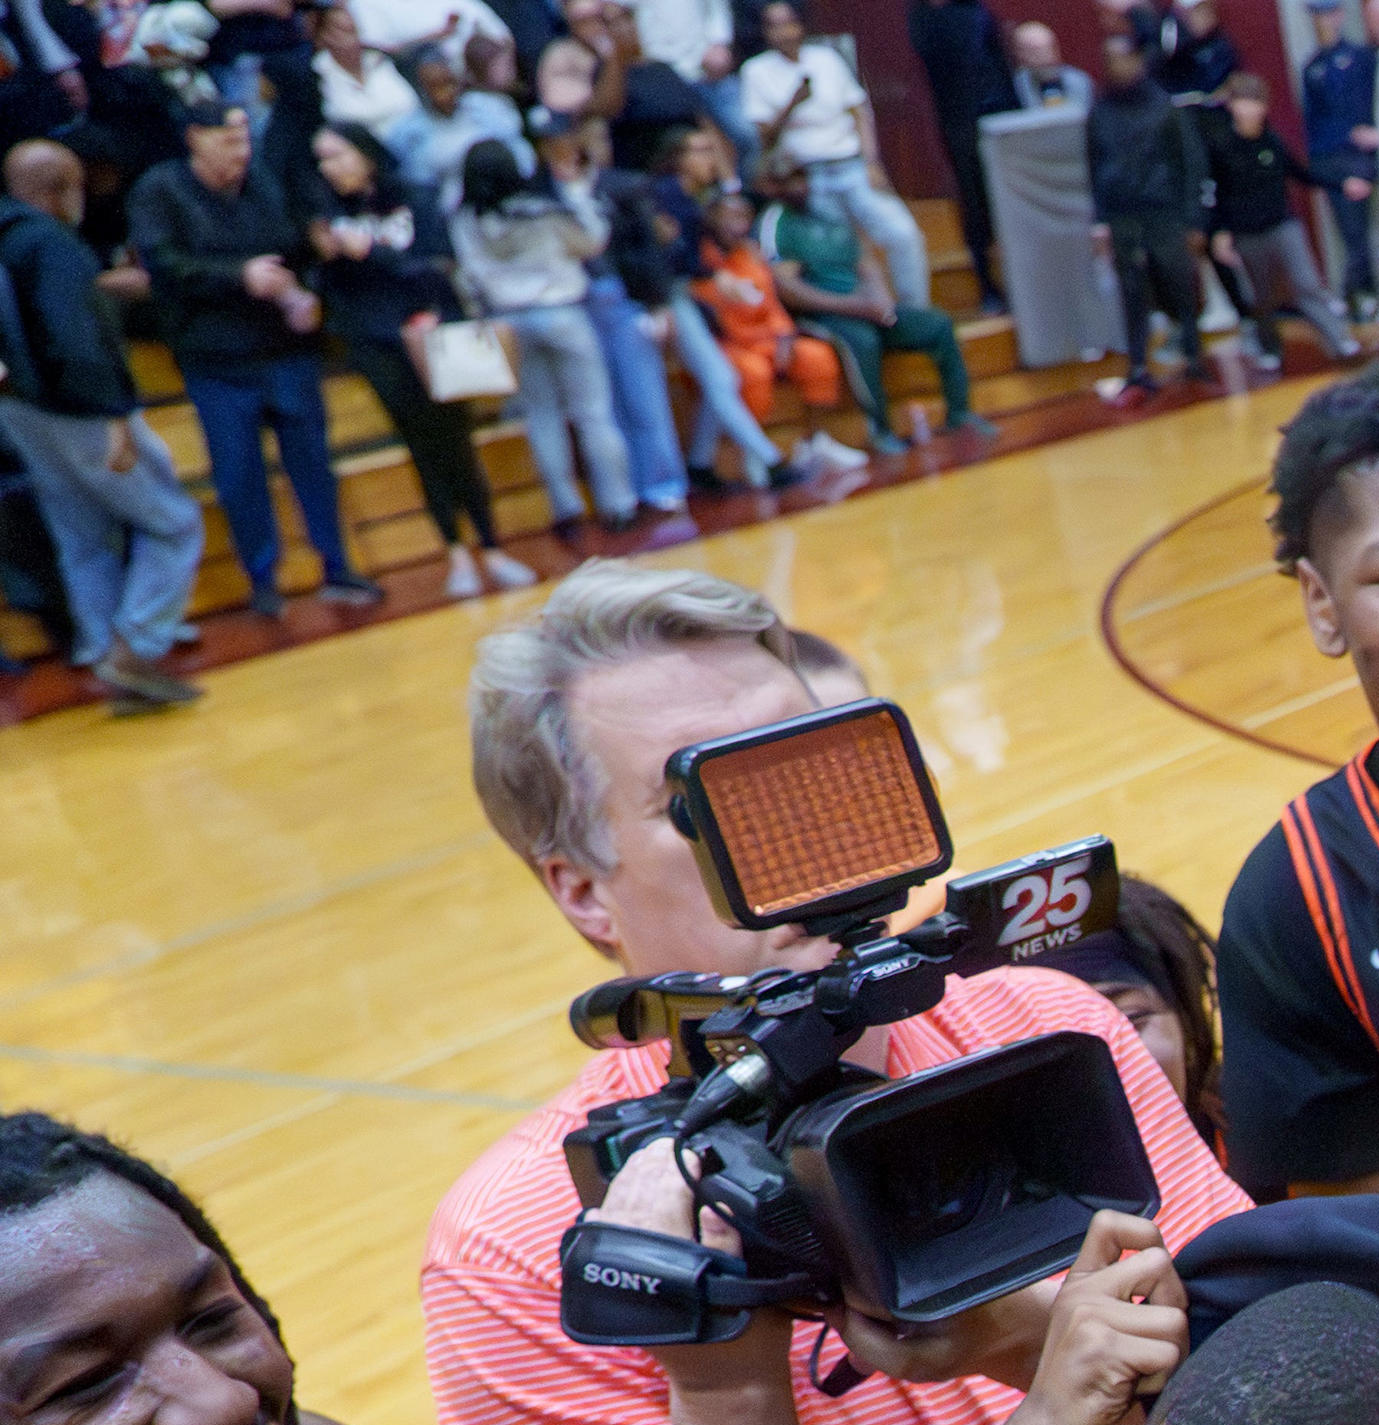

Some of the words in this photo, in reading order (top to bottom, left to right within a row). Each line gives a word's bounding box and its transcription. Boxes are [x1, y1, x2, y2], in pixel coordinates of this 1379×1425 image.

[997, 853, 1092, 947] 25
[1012, 922, 1083, 961] NEWS
[583, 1262, 662, 1295] SONY
